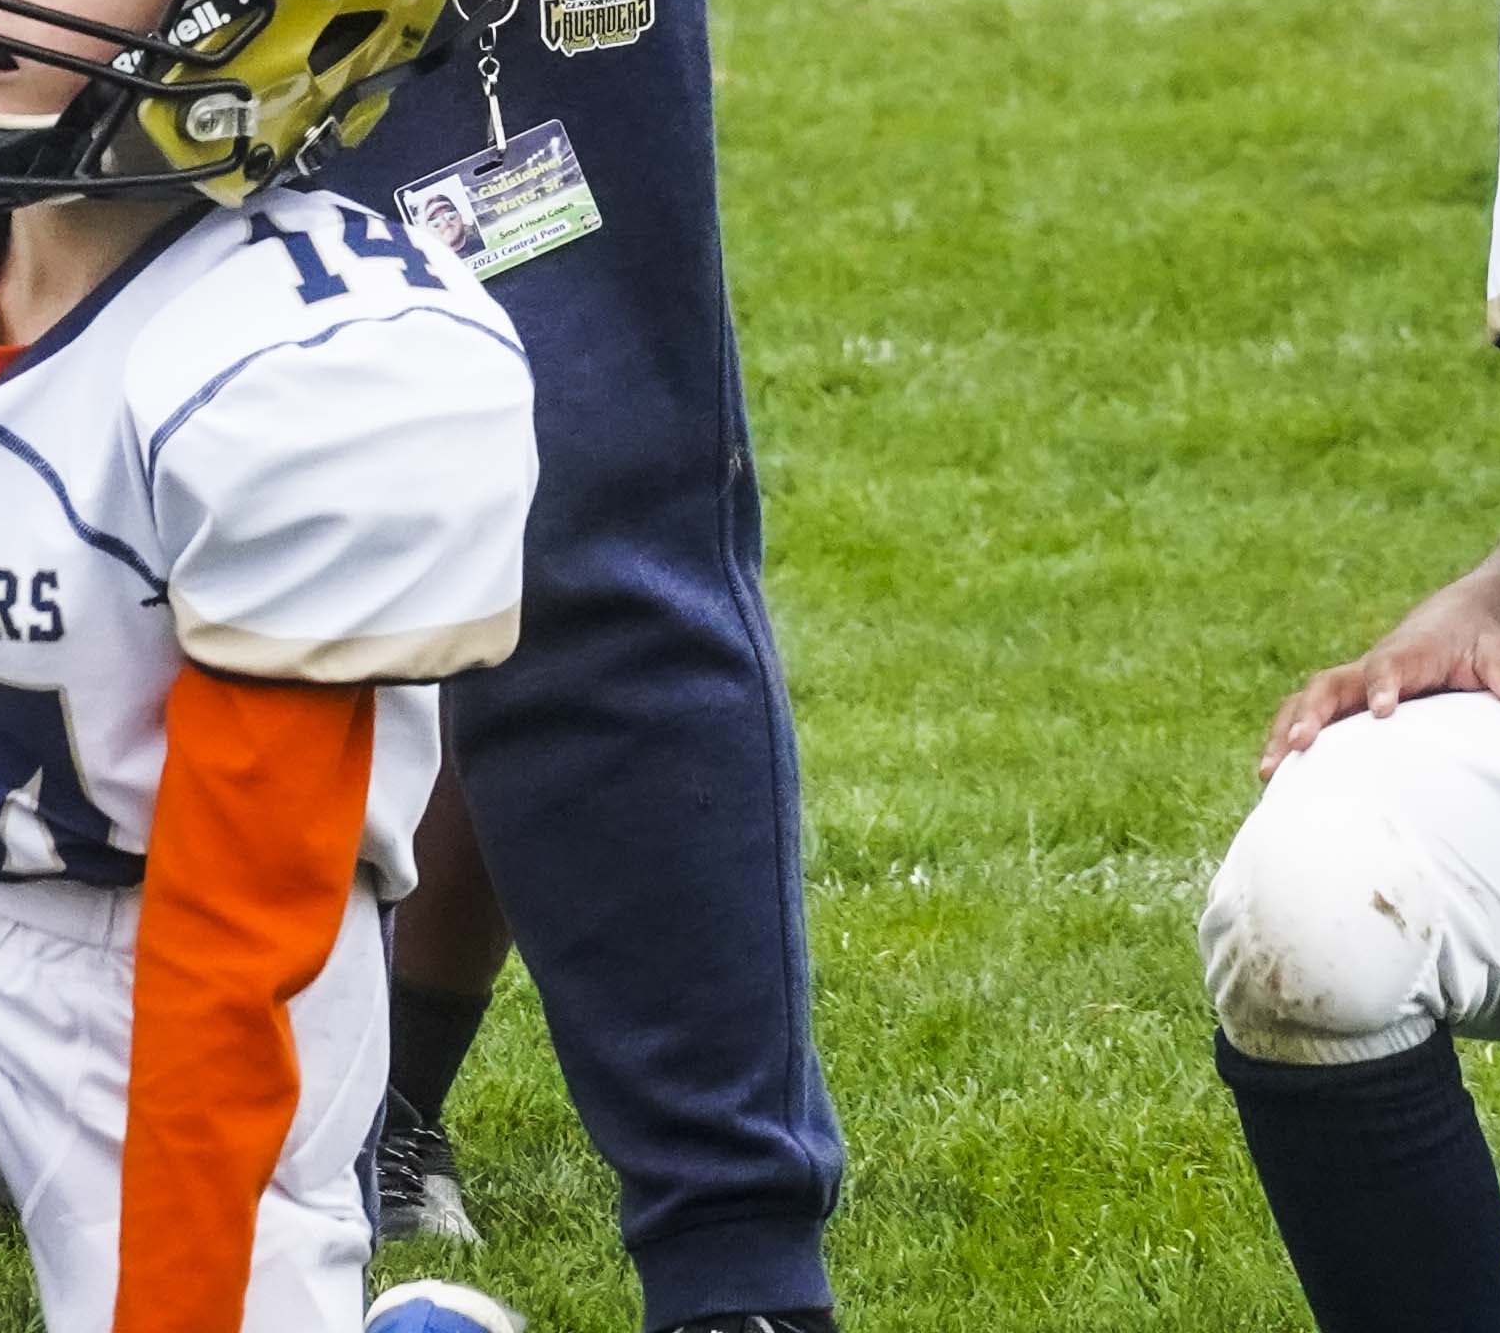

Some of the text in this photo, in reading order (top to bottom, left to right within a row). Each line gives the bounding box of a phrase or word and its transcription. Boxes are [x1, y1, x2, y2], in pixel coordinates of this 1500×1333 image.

[250, 201, 451, 306] 14
[471, 252, 500, 270] 2023
[502, 233, 538, 257] Central
[540, 222, 567, 240] Penn
